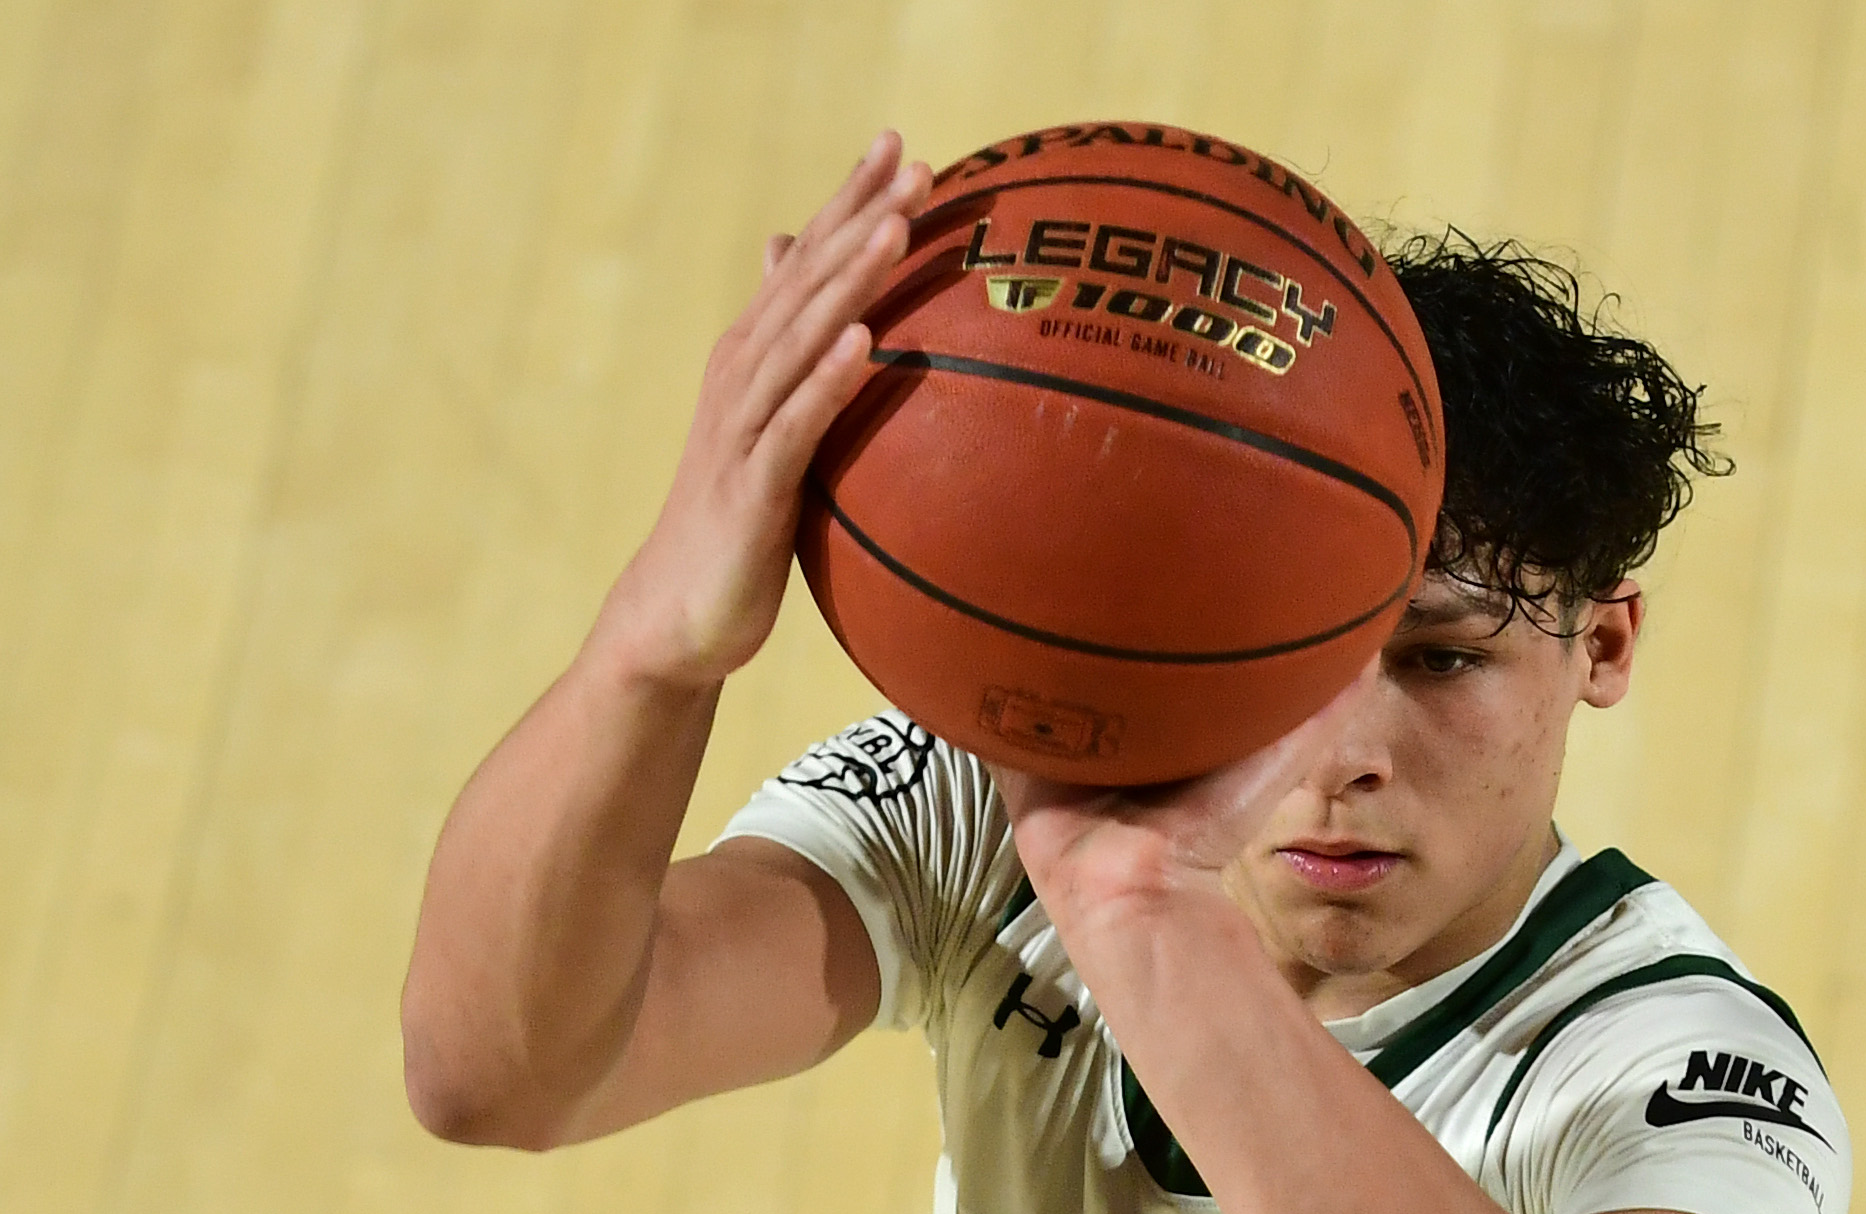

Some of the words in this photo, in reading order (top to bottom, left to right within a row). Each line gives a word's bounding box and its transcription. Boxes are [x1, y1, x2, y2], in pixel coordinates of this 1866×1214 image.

[964, 124, 1376, 278] SPALDING
[962, 218, 1337, 347] LEGACY
[1071, 281, 1296, 375] 1000
[1040, 318, 1121, 347] OFFICIAL
[1130, 332, 1177, 364] GAME
[1184, 348, 1226, 381] BALL
[1677, 1049, 1809, 1123] NIKE
